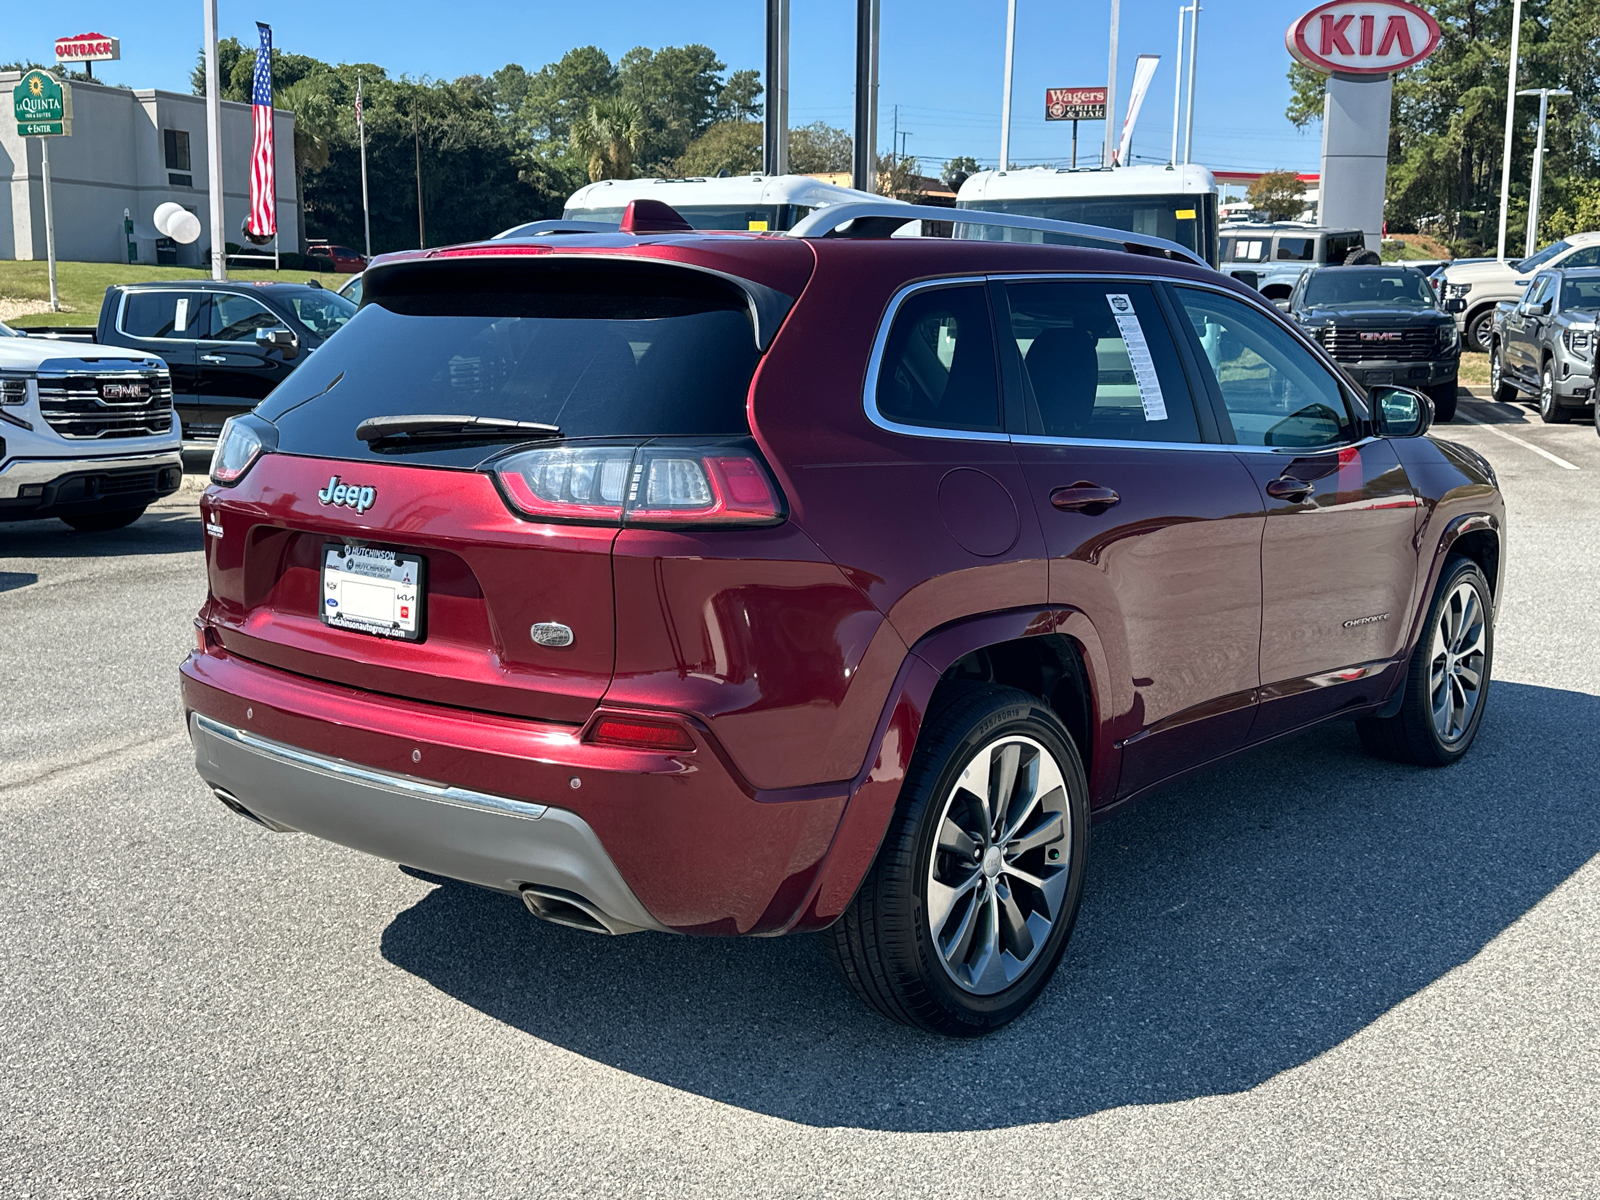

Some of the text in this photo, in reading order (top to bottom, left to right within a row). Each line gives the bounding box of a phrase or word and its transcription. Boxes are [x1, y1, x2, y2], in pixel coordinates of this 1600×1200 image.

[1319, 14, 1415, 56] KIA
[55, 42, 112, 57] OUTBACK
[1049, 89, 1104, 104] Wagers
[22, 97, 60, 113] QUINTA
[33, 125, 52, 133] ENTER
[1360, 332, 1402, 341] GMC
[103, 384, 150, 398] GMC
[318, 475, 377, 515] Jeep
[352, 547, 396, 560] HUTCHINSON
[328, 616, 406, 638] Hutchinsonautogroup.com
[1342, 612, 1390, 628] CHEROKEE
[979, 708, 1020, 735] 235/50R19
